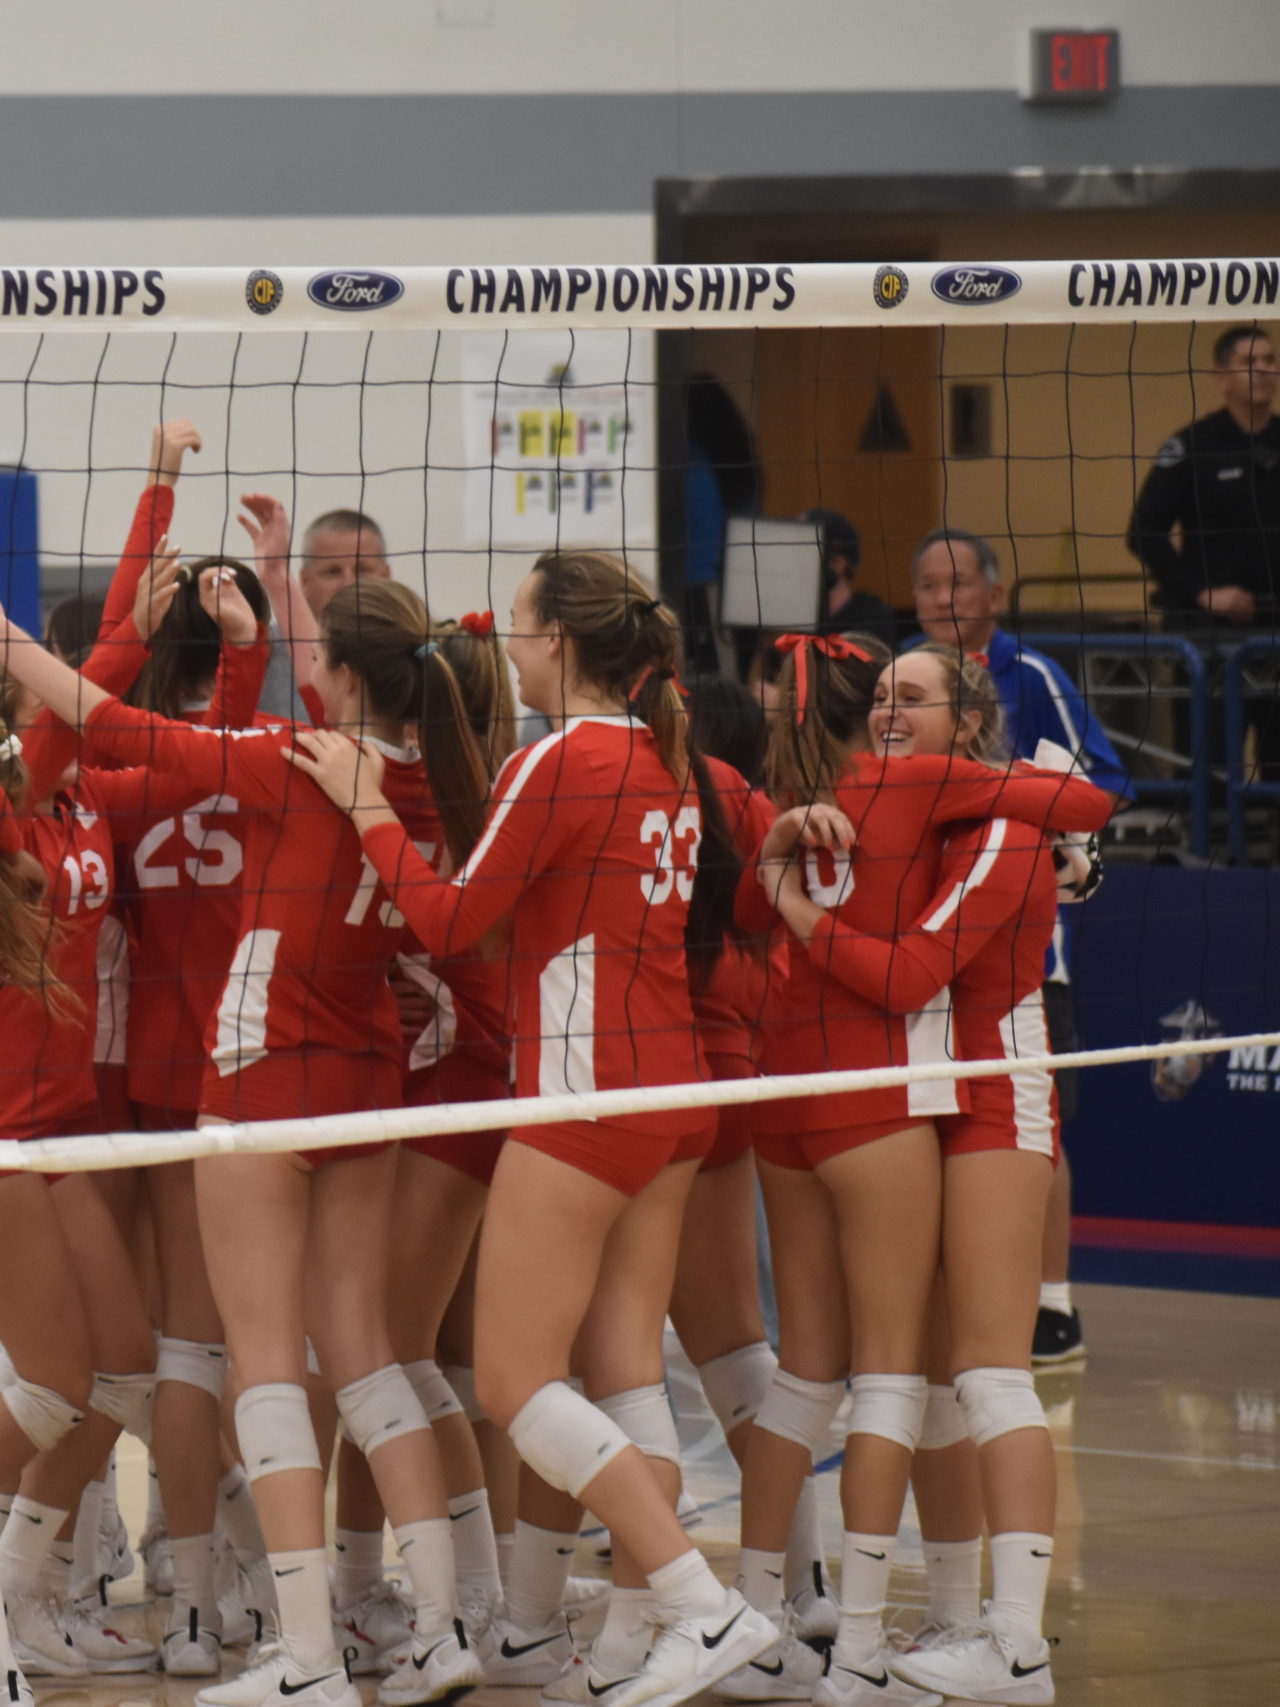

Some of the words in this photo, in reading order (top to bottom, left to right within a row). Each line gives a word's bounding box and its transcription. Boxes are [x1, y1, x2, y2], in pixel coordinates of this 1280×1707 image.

[326, 273, 385, 304] Ford
[446, 266, 796, 314] CHAMPIONSHIPS
[881, 274, 902, 299] CIF
[948, 268, 1004, 299] Ford
[1068, 261, 1279, 307] CHAMPION
[133, 793, 244, 889] 25
[640, 806, 702, 906] 33
[63, 849, 109, 916] 13
[1226, 1073, 1267, 1092] THE
